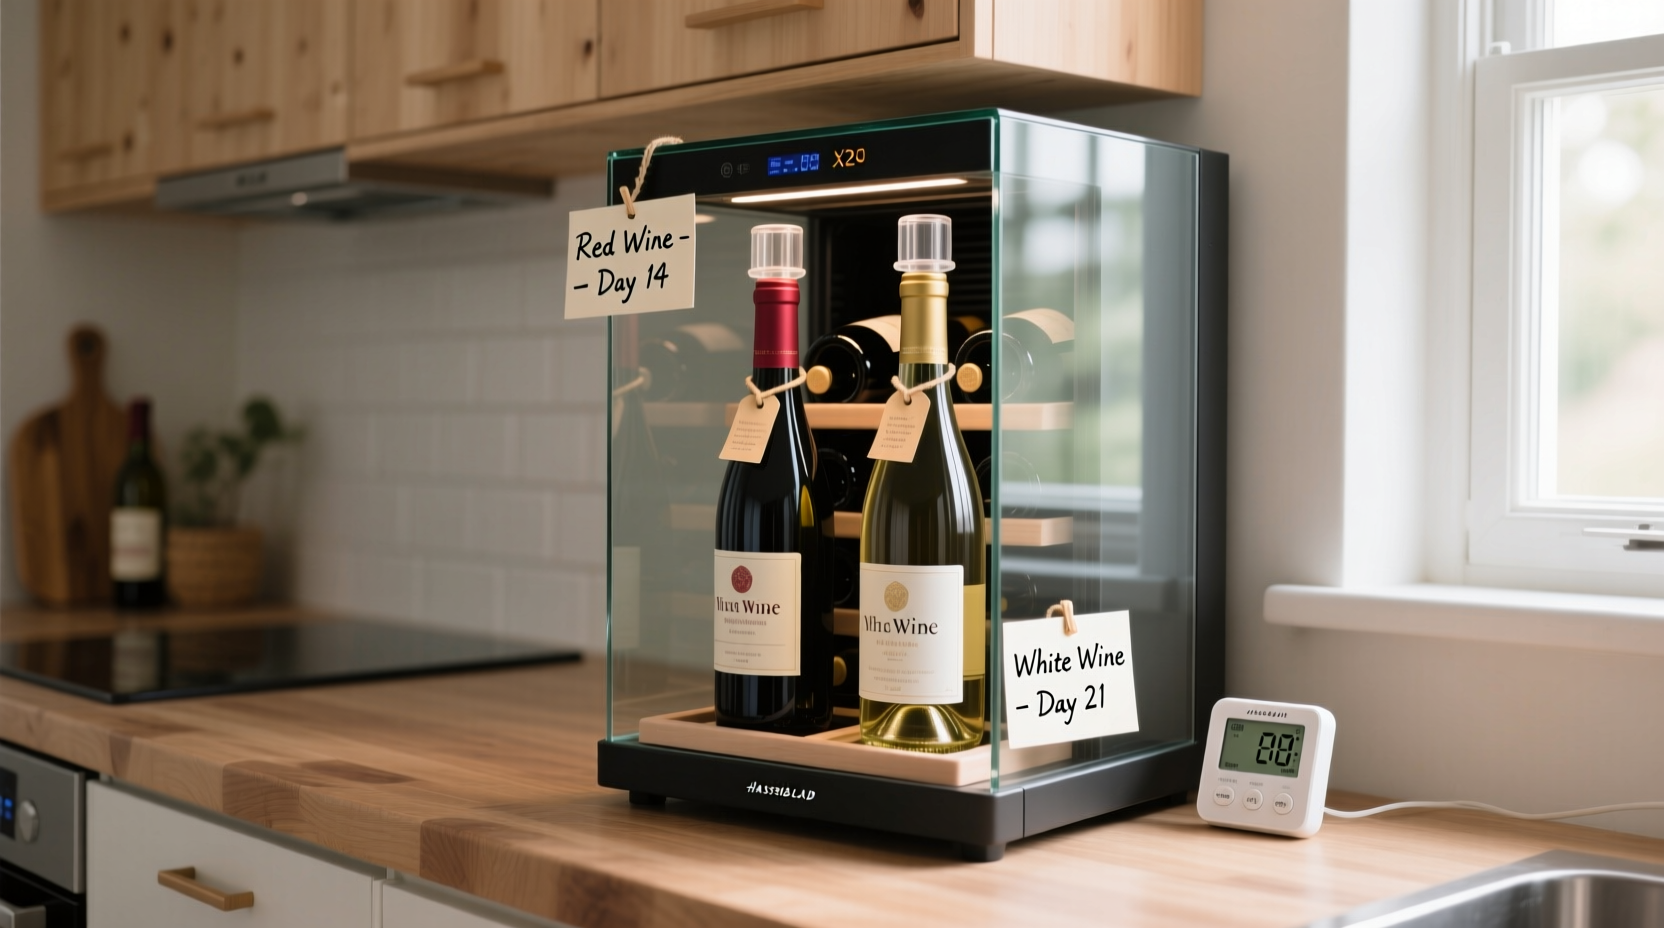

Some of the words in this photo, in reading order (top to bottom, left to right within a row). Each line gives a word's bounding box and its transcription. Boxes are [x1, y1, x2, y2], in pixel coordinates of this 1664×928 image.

[832, 148, 866, 168] X20
[576, 229, 616, 261] Red
[623, 224, 674, 254] Wine
[597, 268, 637, 304] Day
[646, 261, 669, 289] 14
[742, 599, 781, 615] Wine
[893, 617, 938, 635] Wine
[1013, 647, 1072, 678] White
[1077, 642, 1126, 670] Wine
[1036, 689, 1077, 725] Day
[1084, 682, 1105, 710] 21
